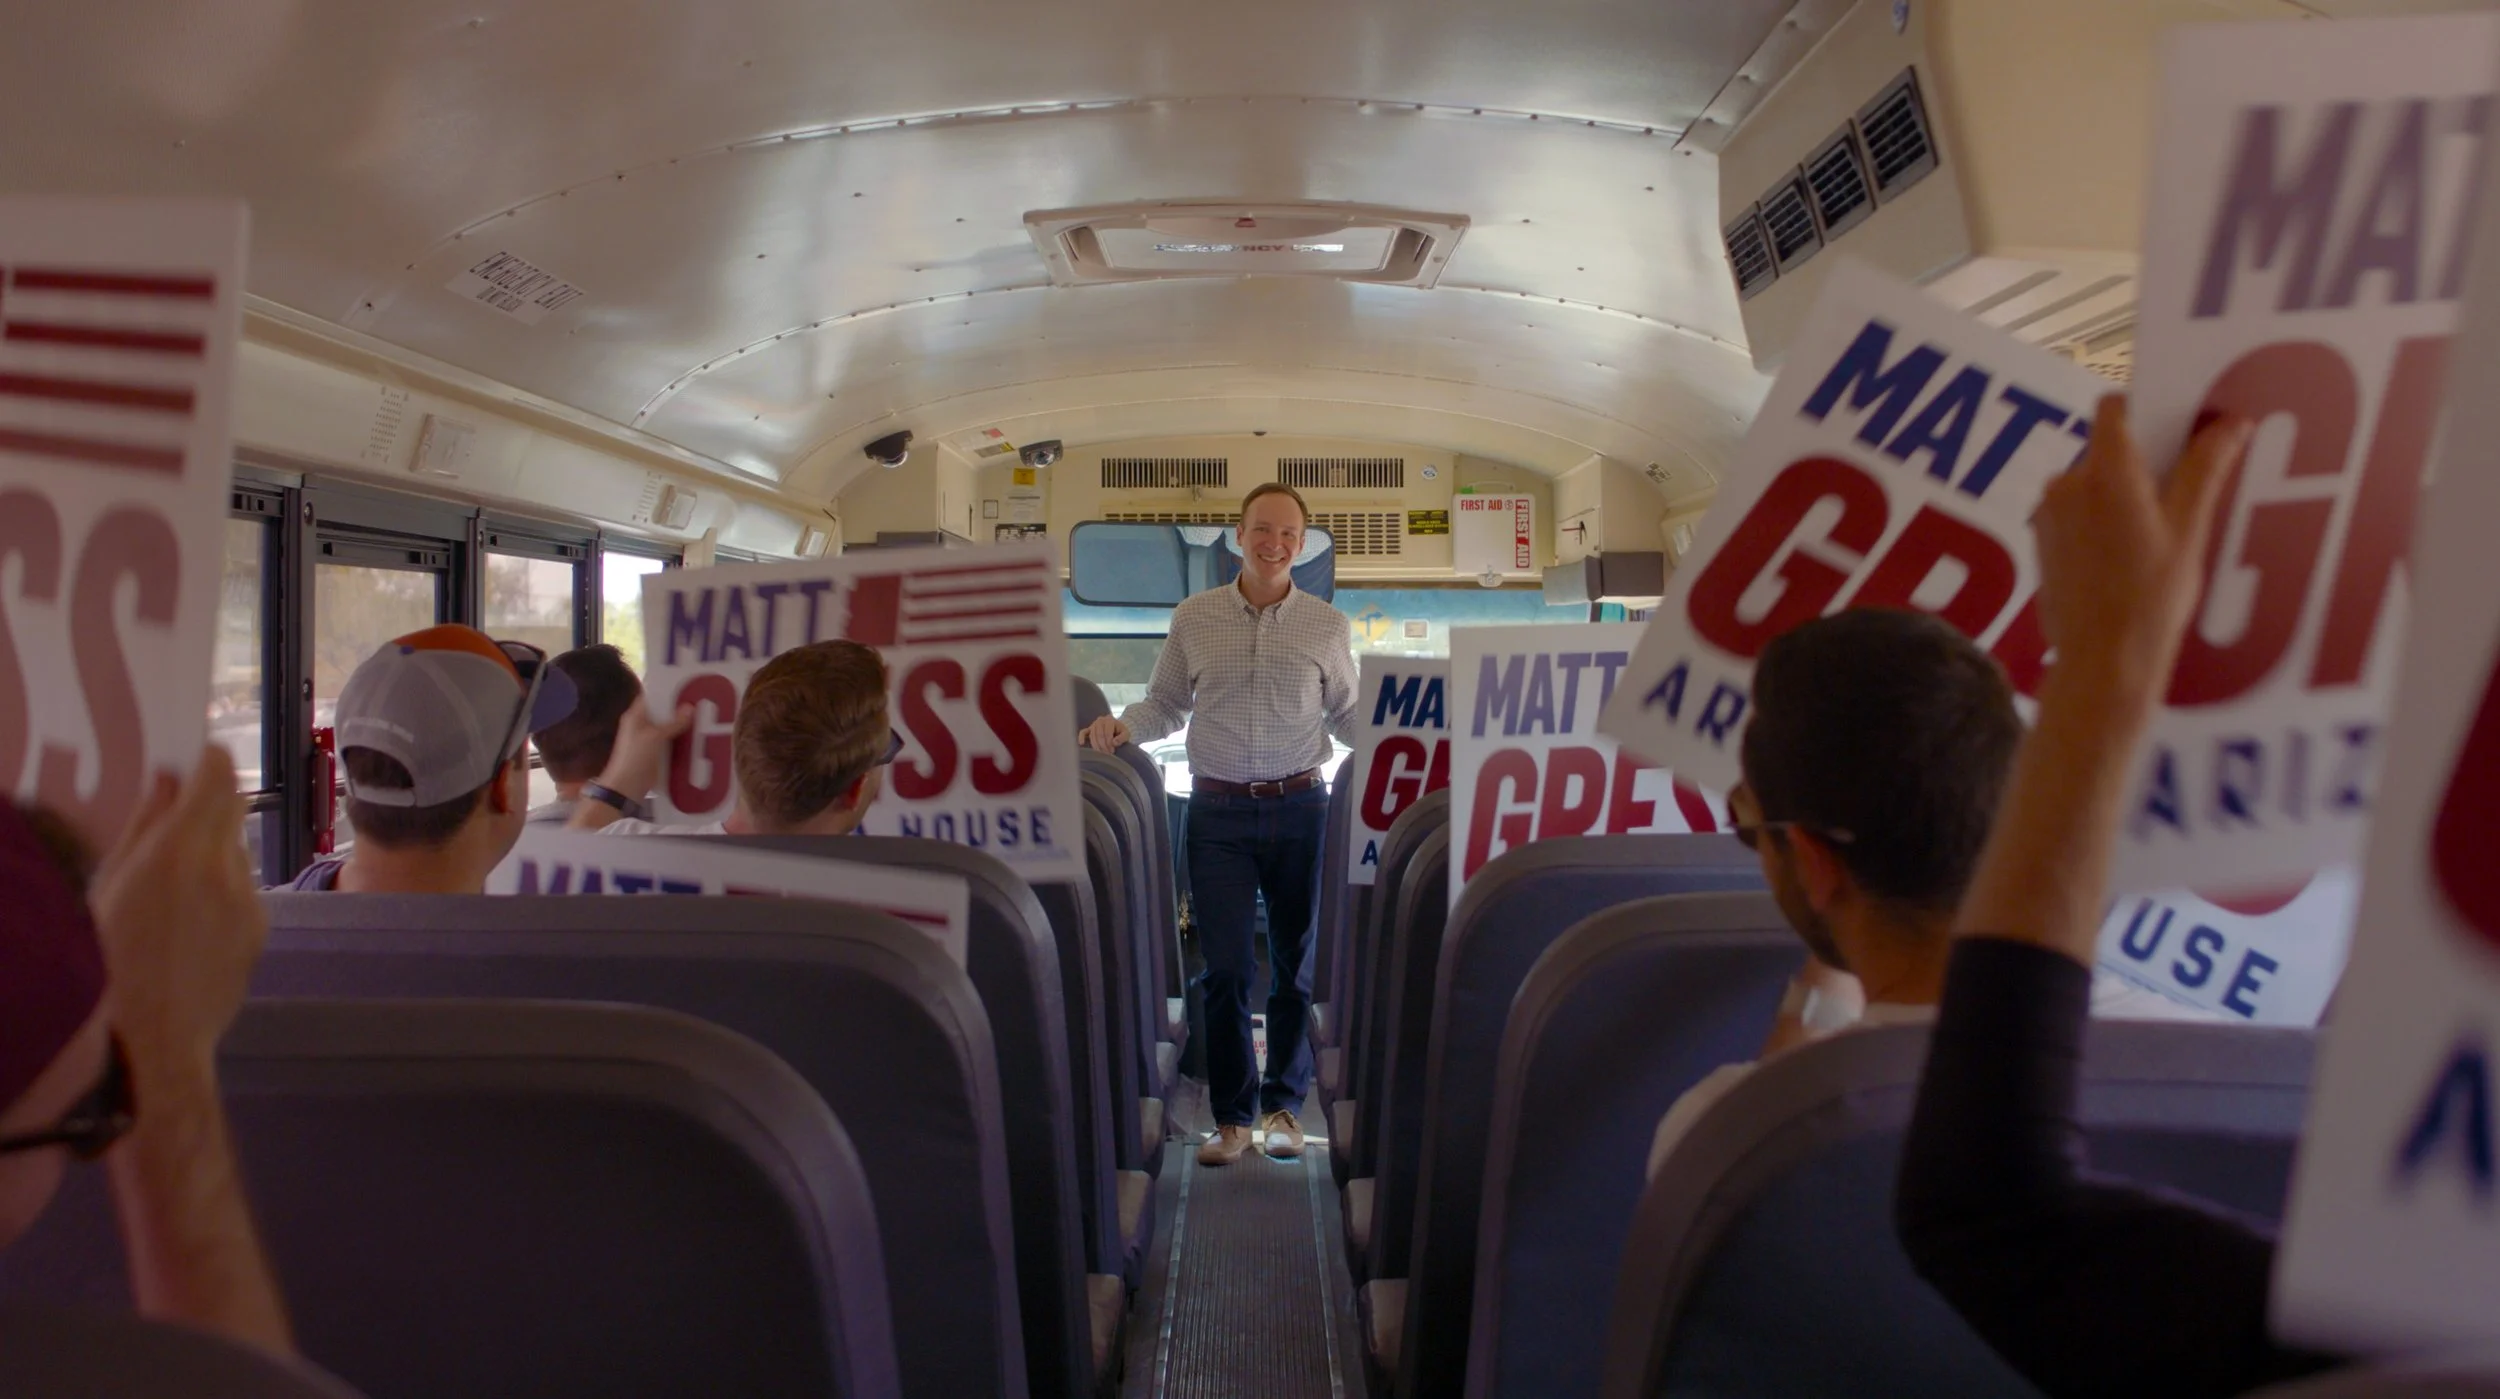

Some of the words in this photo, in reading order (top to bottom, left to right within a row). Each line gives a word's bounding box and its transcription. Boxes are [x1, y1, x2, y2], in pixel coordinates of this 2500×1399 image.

[1799, 318, 2093, 500] MAT
[1460, 499, 1485, 511] FIRST
[1488, 499, 1503, 511] AID
[1516, 500, 1530, 538] FIRST
[1516, 543, 1530, 568] AID
[664, 578, 834, 666] MATT
[666, 654, 1048, 815] GSS
[1371, 674, 1447, 729] MA
[1471, 651, 1629, 739] MATT
[901, 803, 1054, 847] HOUSE
[2130, 720, 2380, 842] ARIZ
[2119, 898, 2280, 1019] USE
